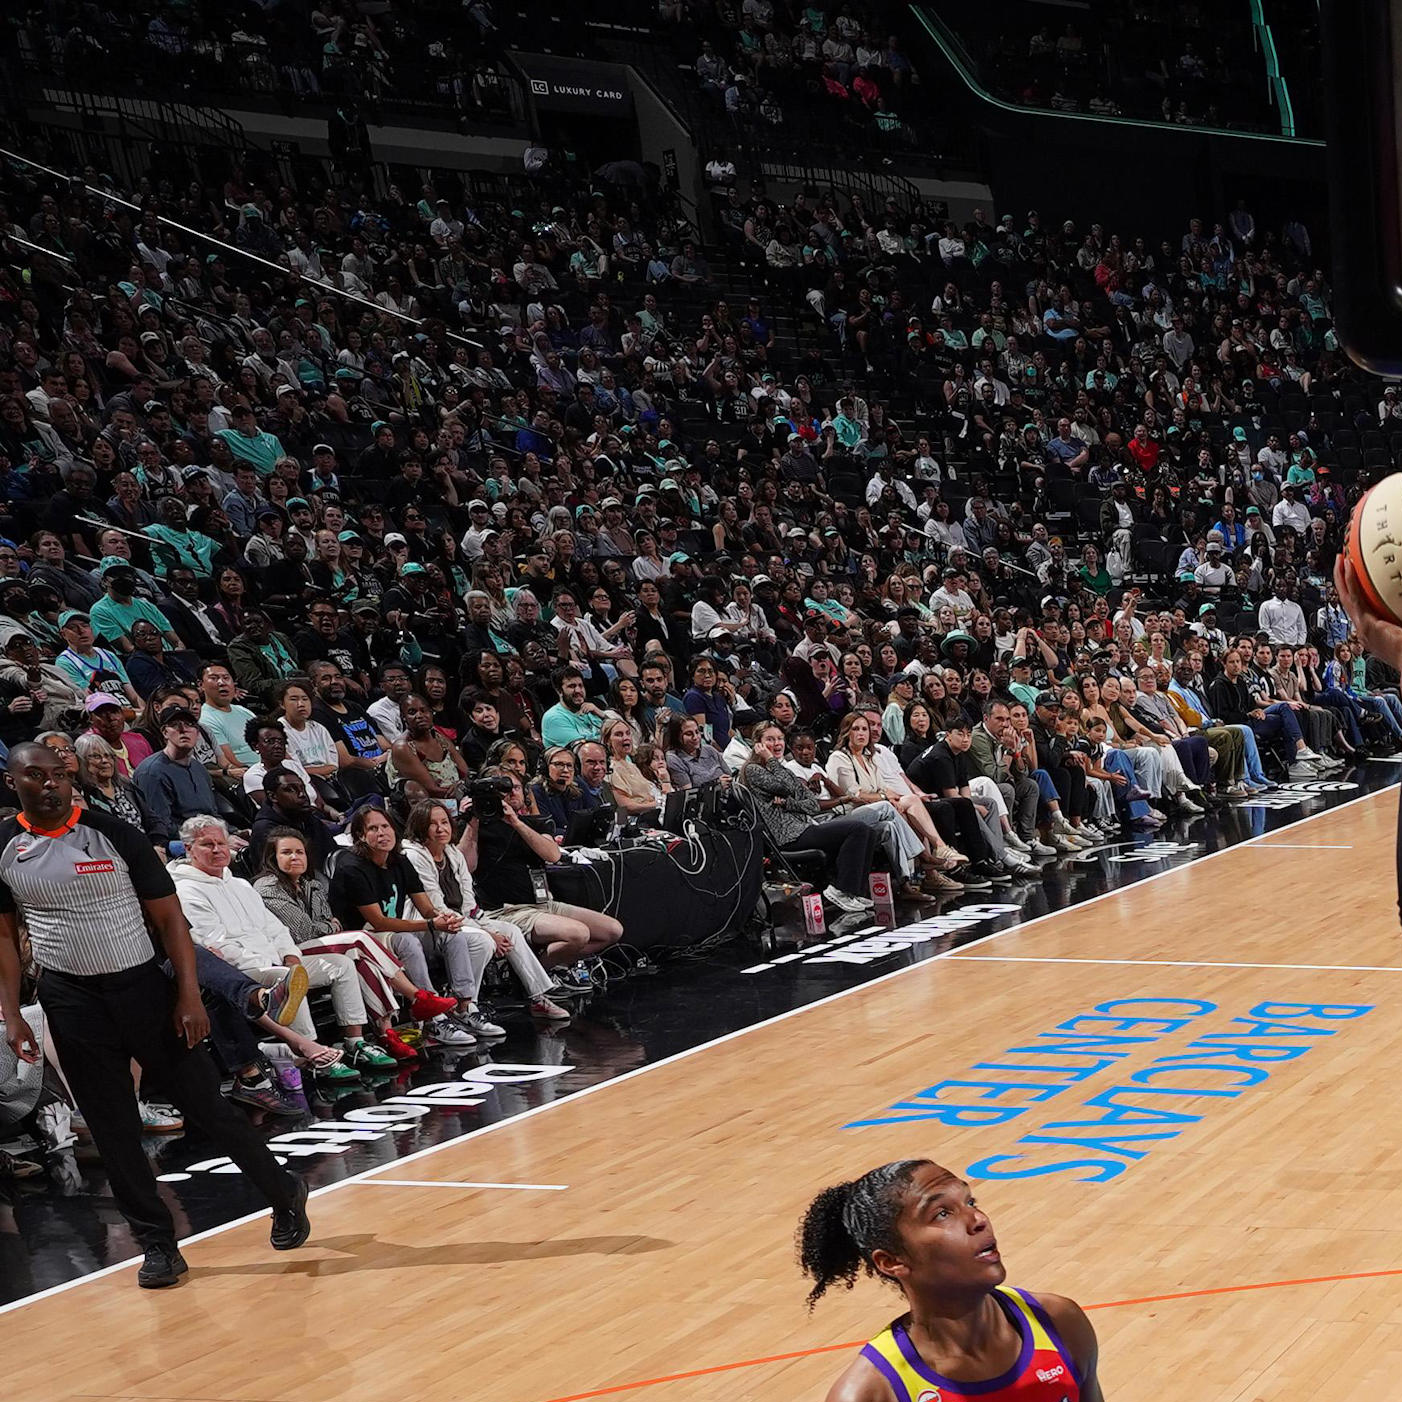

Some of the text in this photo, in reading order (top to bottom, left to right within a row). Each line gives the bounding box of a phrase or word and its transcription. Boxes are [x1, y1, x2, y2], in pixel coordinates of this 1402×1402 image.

[553, 85, 592, 97] LUXURY
[595, 89, 623, 100] CARD
[76, 861, 114, 873] Emirates
[841, 996, 1217, 1130] CENTER
[1039, 1365, 1064, 1383] HERO
